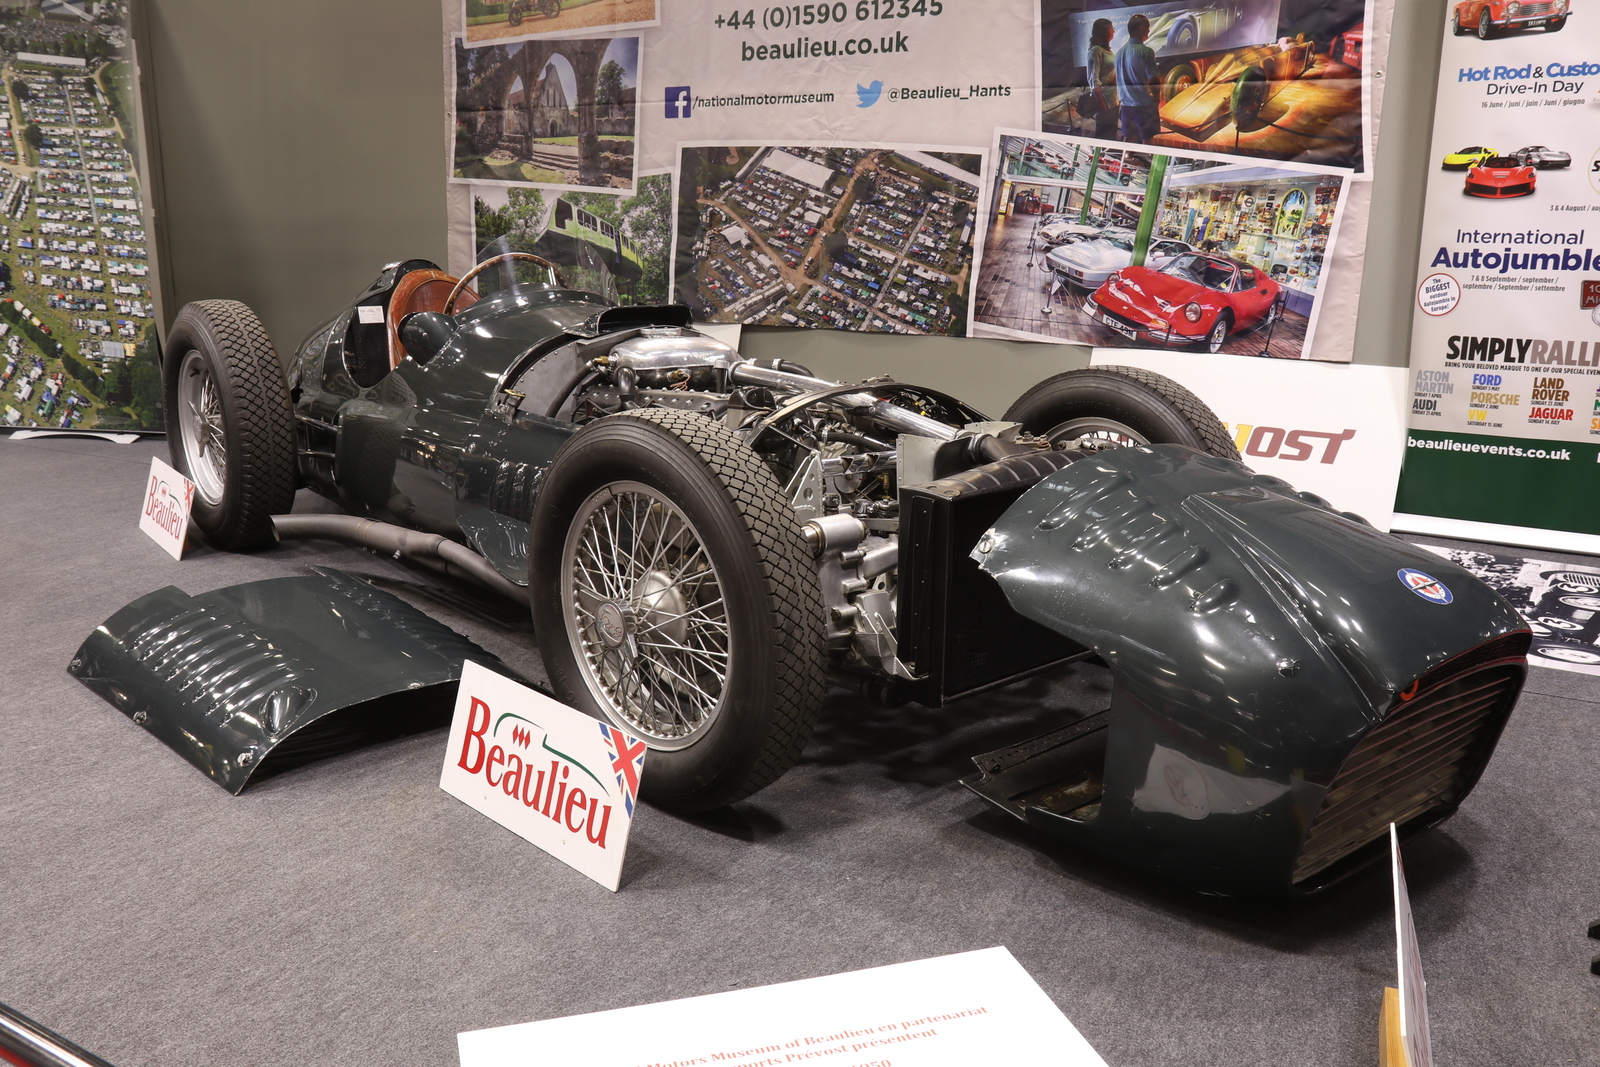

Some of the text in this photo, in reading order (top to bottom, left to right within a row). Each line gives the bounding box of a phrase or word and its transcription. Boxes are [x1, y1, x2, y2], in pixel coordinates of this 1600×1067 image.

[714, 0, 943, 31] +44 (0)1590 612345
[741, 31, 909, 61] beaulieu.co.uk
[1458, 67, 1491, 82] Hot
[1493, 64, 1532, 80] Rod
[1532, 66, 1544, 78] &
[887, 84, 1011, 103] @Beaulieu_Hants
[1487, 80, 1584, 95] Drive-In Day
[692, 91, 835, 109] /nationalmotormuseum
[1456, 229, 1585, 245] International
[1486, 275, 1517, 283] September
[1425, 282, 1450, 294] BIGGEST
[1416, 370, 1450, 382] ASTON
[1473, 374, 1502, 386] FORD
[1534, 377, 1564, 389] LAND
[1415, 381, 1454, 394] MARTIN
[1532, 388, 1570, 402] ROVER
[1413, 398, 1437, 411] AUDI
[1470, 392, 1520, 406] PORSCHE
[1468, 409, 1488, 421] VW
[1529, 407, 1574, 420] JAGUAR
[1407, 436, 1572, 461] beaulieuevents.co.uk
[145, 475, 183, 541] Beaulieu
[457, 696, 612, 850] Beaulieu
[711, 1044, 781, 1062] Museum
[785, 1038, 801, 1049] of
[803, 1028, 874, 1046] Beaulieu
[878, 1023, 898, 1032] en
[900, 1006, 989, 1030] partenariat
[785, 1044, 848, 1062] Prévost
[851, 1028, 939, 1052] présentent
